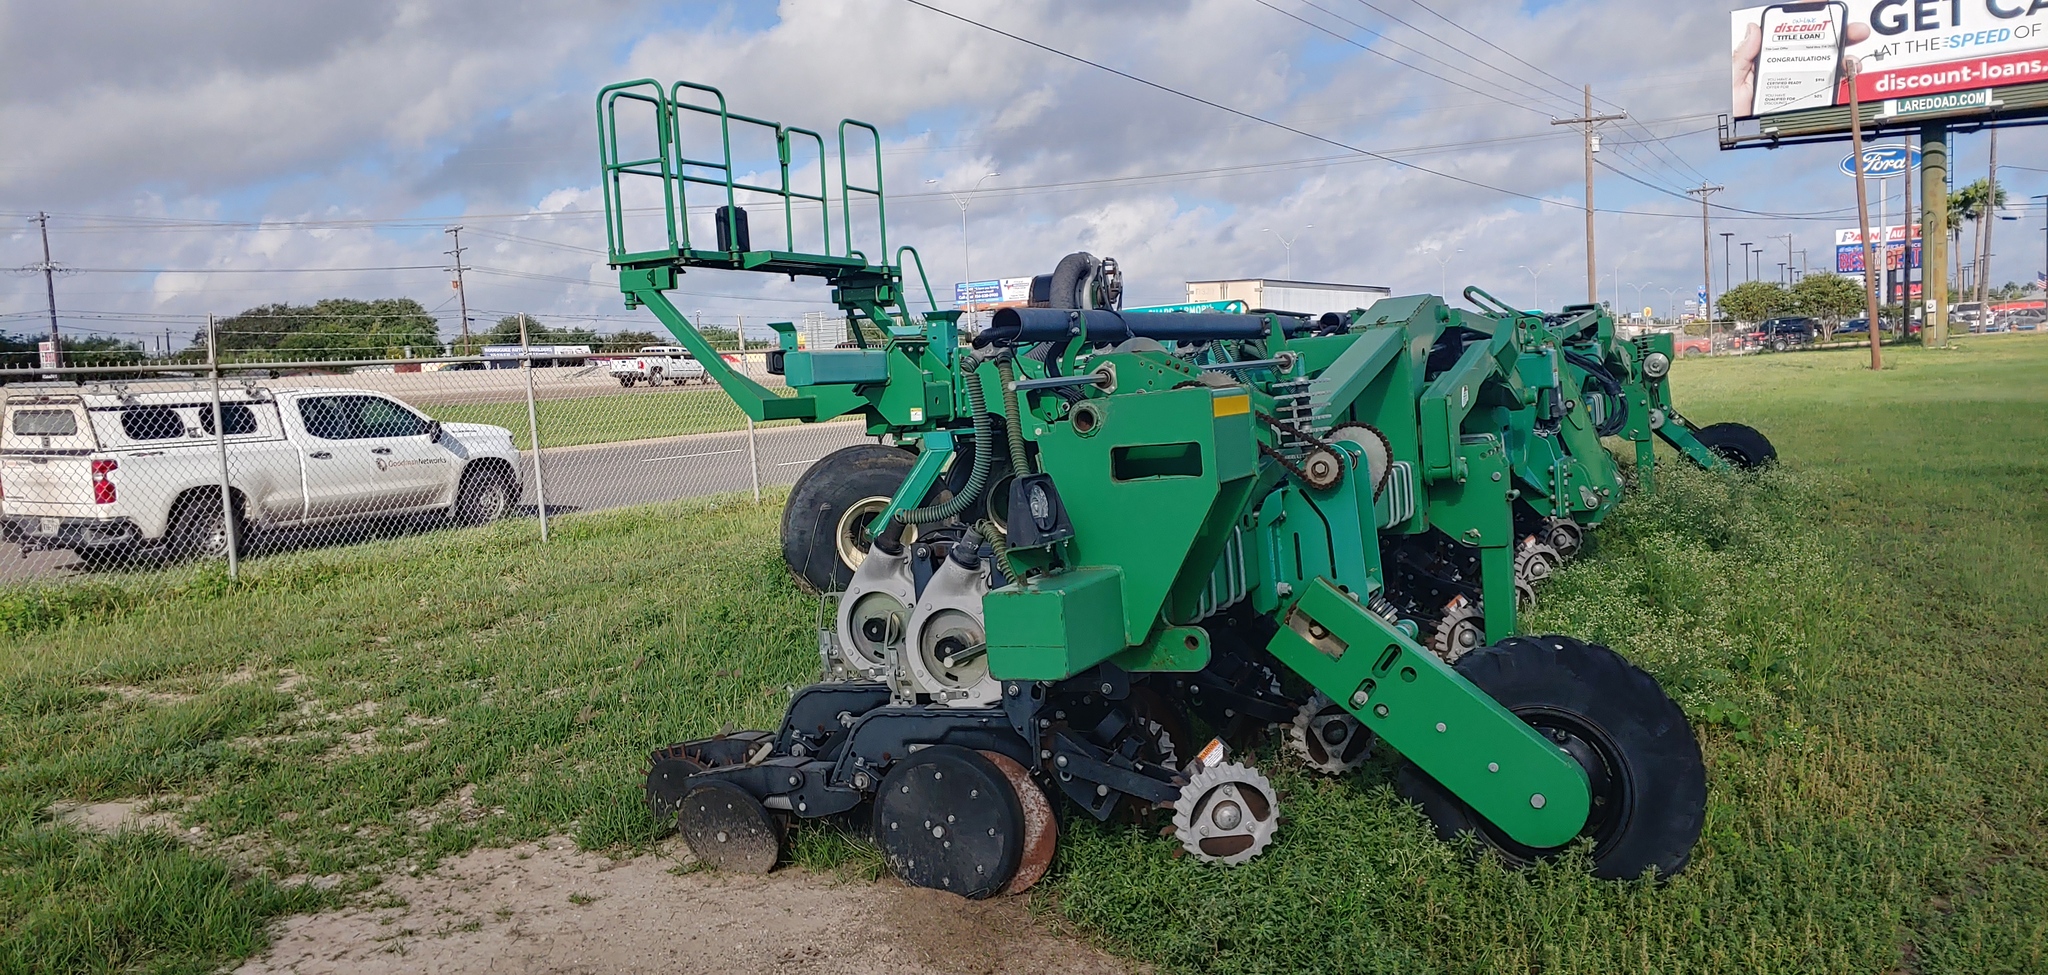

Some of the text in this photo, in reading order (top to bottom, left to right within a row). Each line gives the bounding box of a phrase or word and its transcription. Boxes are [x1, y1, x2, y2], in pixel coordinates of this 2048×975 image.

[1882, 23, 2042, 56] AT THE SPEED OF
[1767, 55, 1831, 63] CONGRATULATIONS
[1898, 92, 1985, 112] LAREDOAD.COM
[1863, 150, 1906, 172] Ford
[1842, 231, 1888, 242] PAN
[1838, 251, 1866, 269] BES
